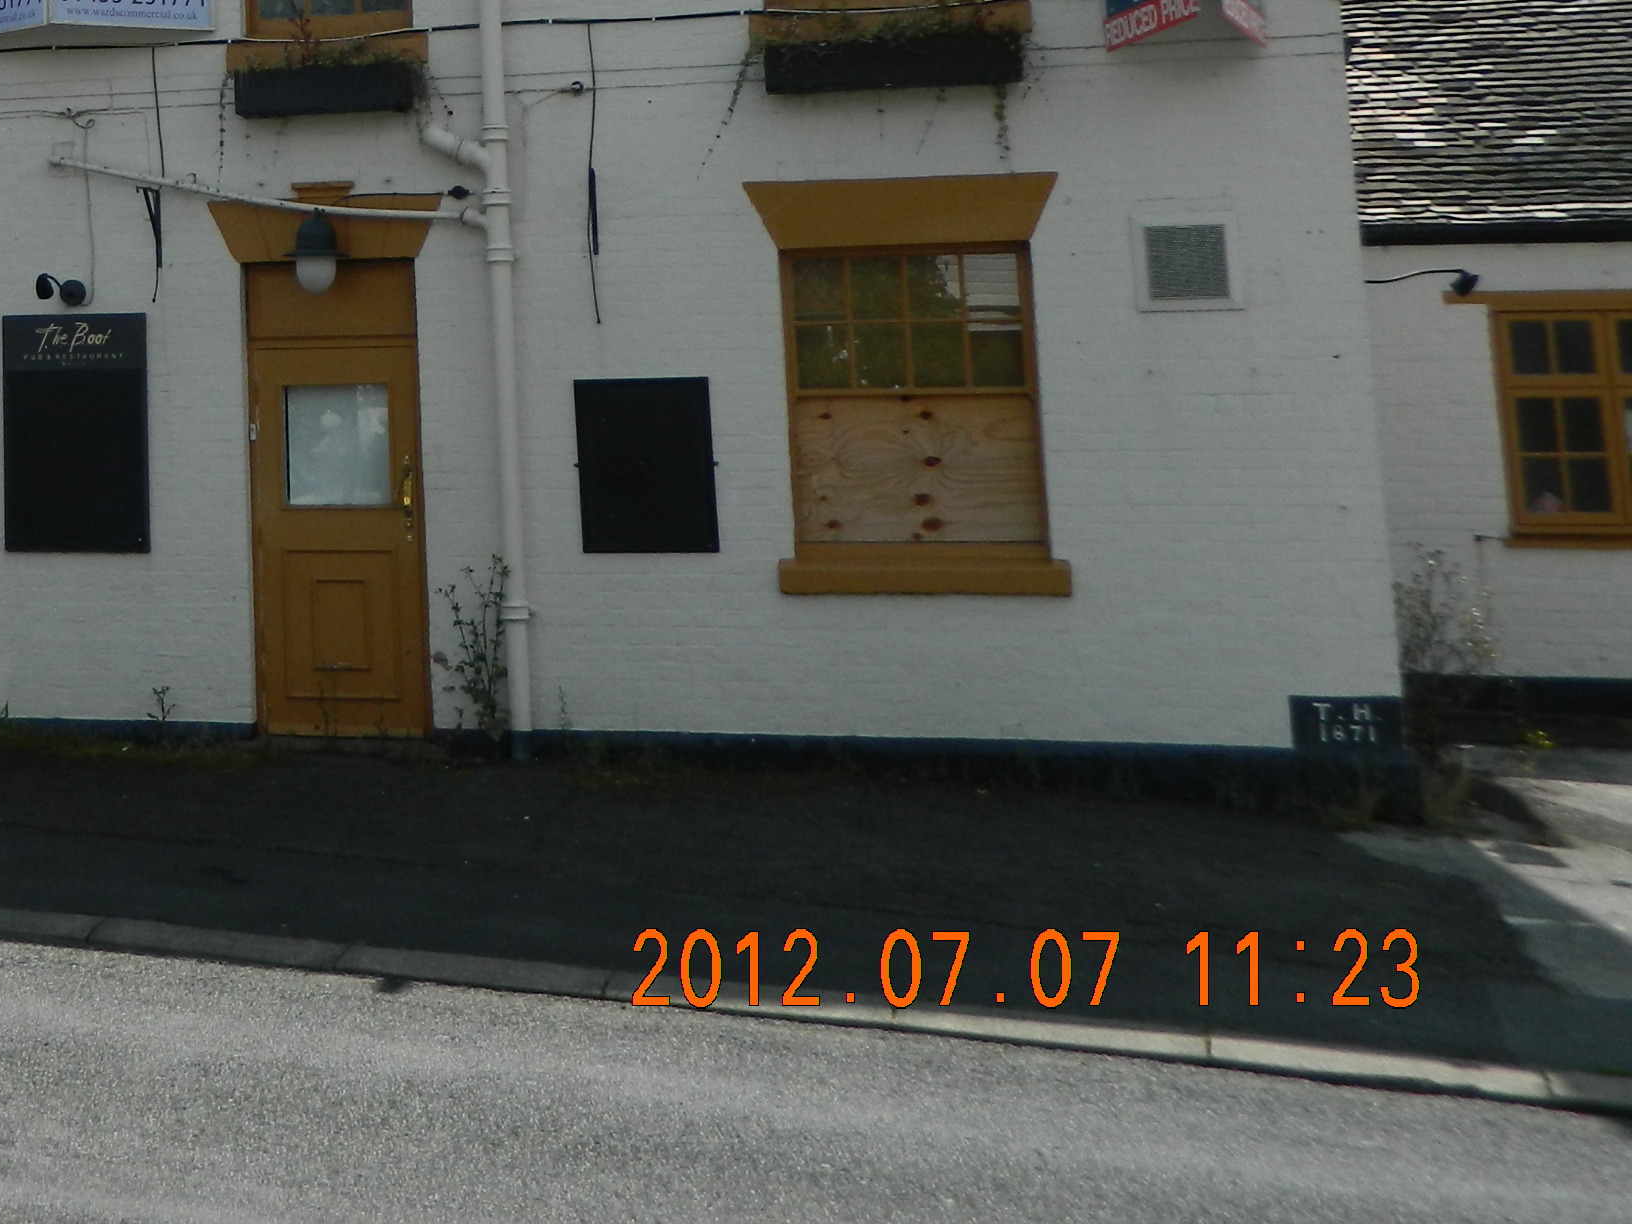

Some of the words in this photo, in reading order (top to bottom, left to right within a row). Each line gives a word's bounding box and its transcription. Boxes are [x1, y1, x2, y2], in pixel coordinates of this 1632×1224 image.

[66, 7, 198, 21] www.wardscommercial.co.uk
[1104, 3, 1158, 46] REDUCED
[35, 323, 69, 353] The
[69, 322, 112, 353] Boot
